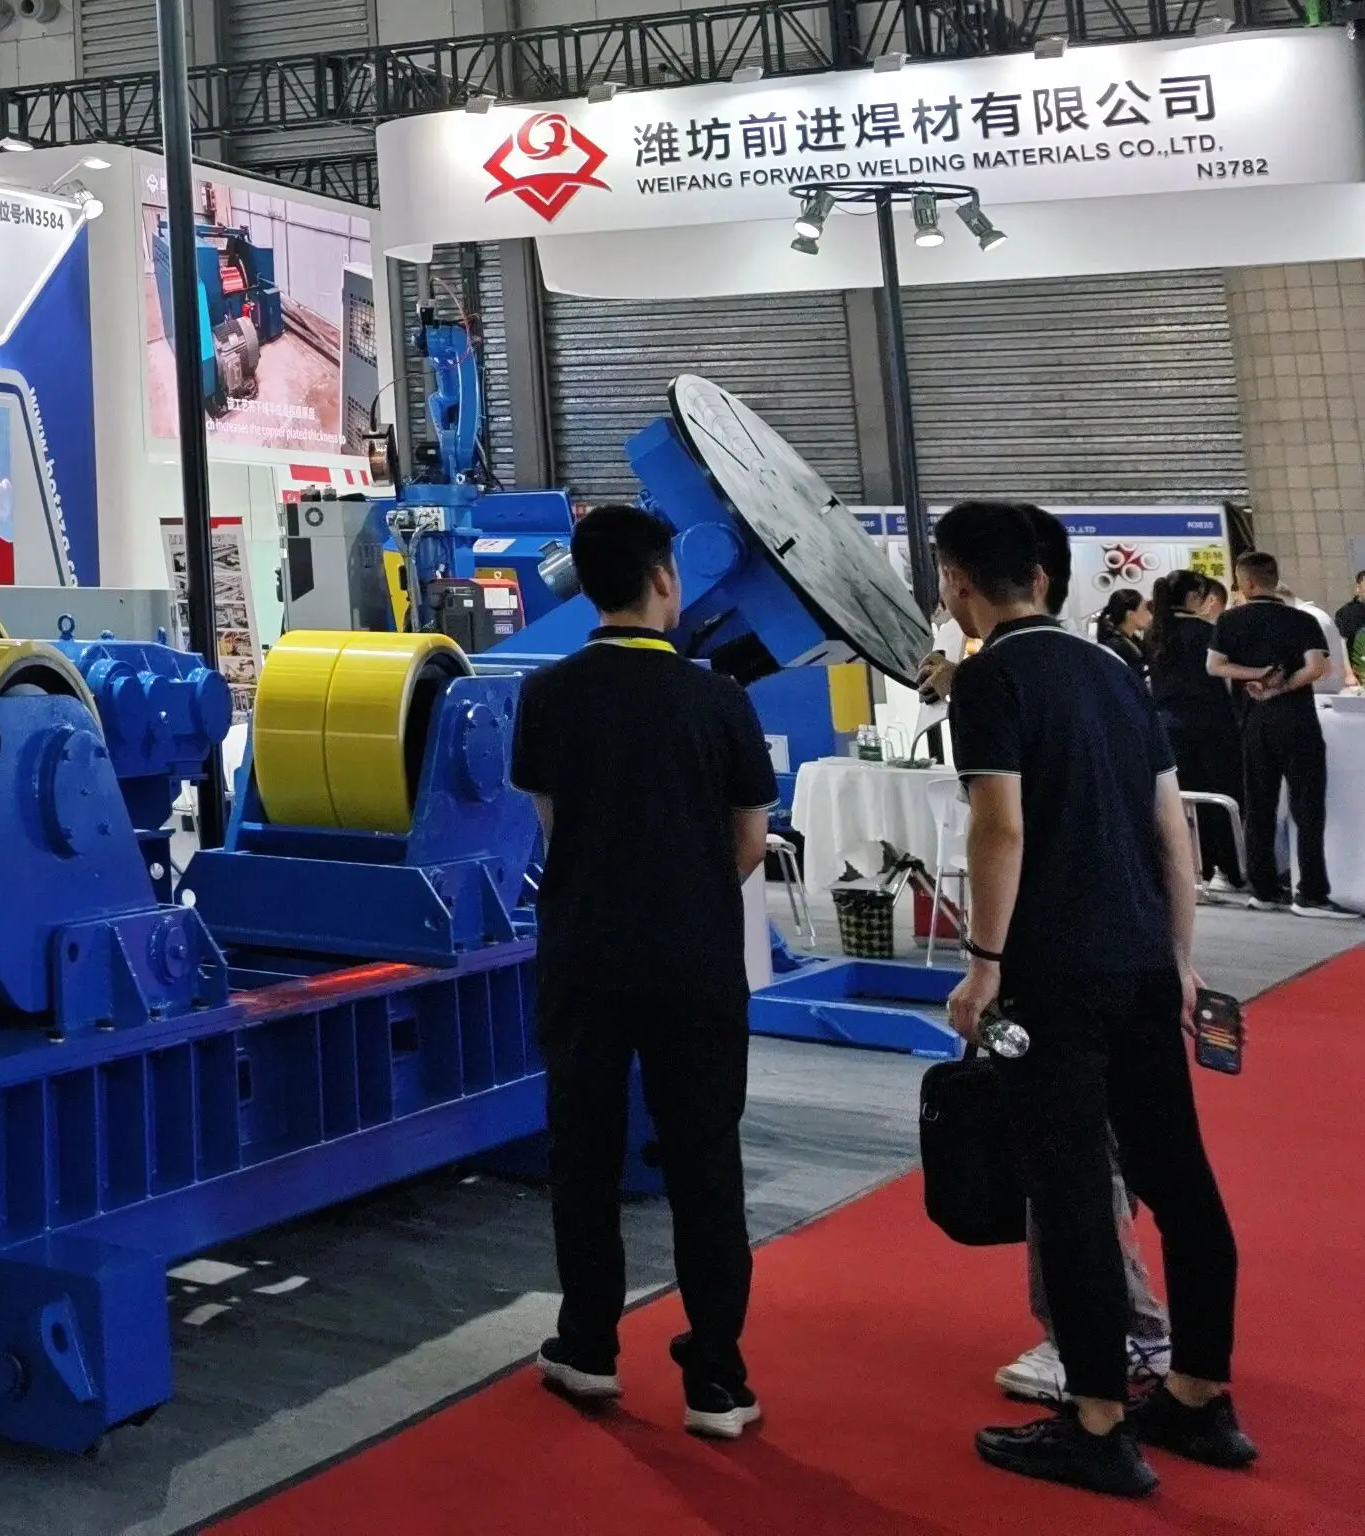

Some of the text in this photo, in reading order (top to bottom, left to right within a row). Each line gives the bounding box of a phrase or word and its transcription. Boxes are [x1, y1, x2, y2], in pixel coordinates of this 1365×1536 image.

[632, 73, 1218, 167] 潍坊前进焊材有限公司
[637, 133, 1224, 195] WEIFANG FORWARD WELDING MATERIALS CO.,LTD.
[1196, 158, 1269, 181] N3782
